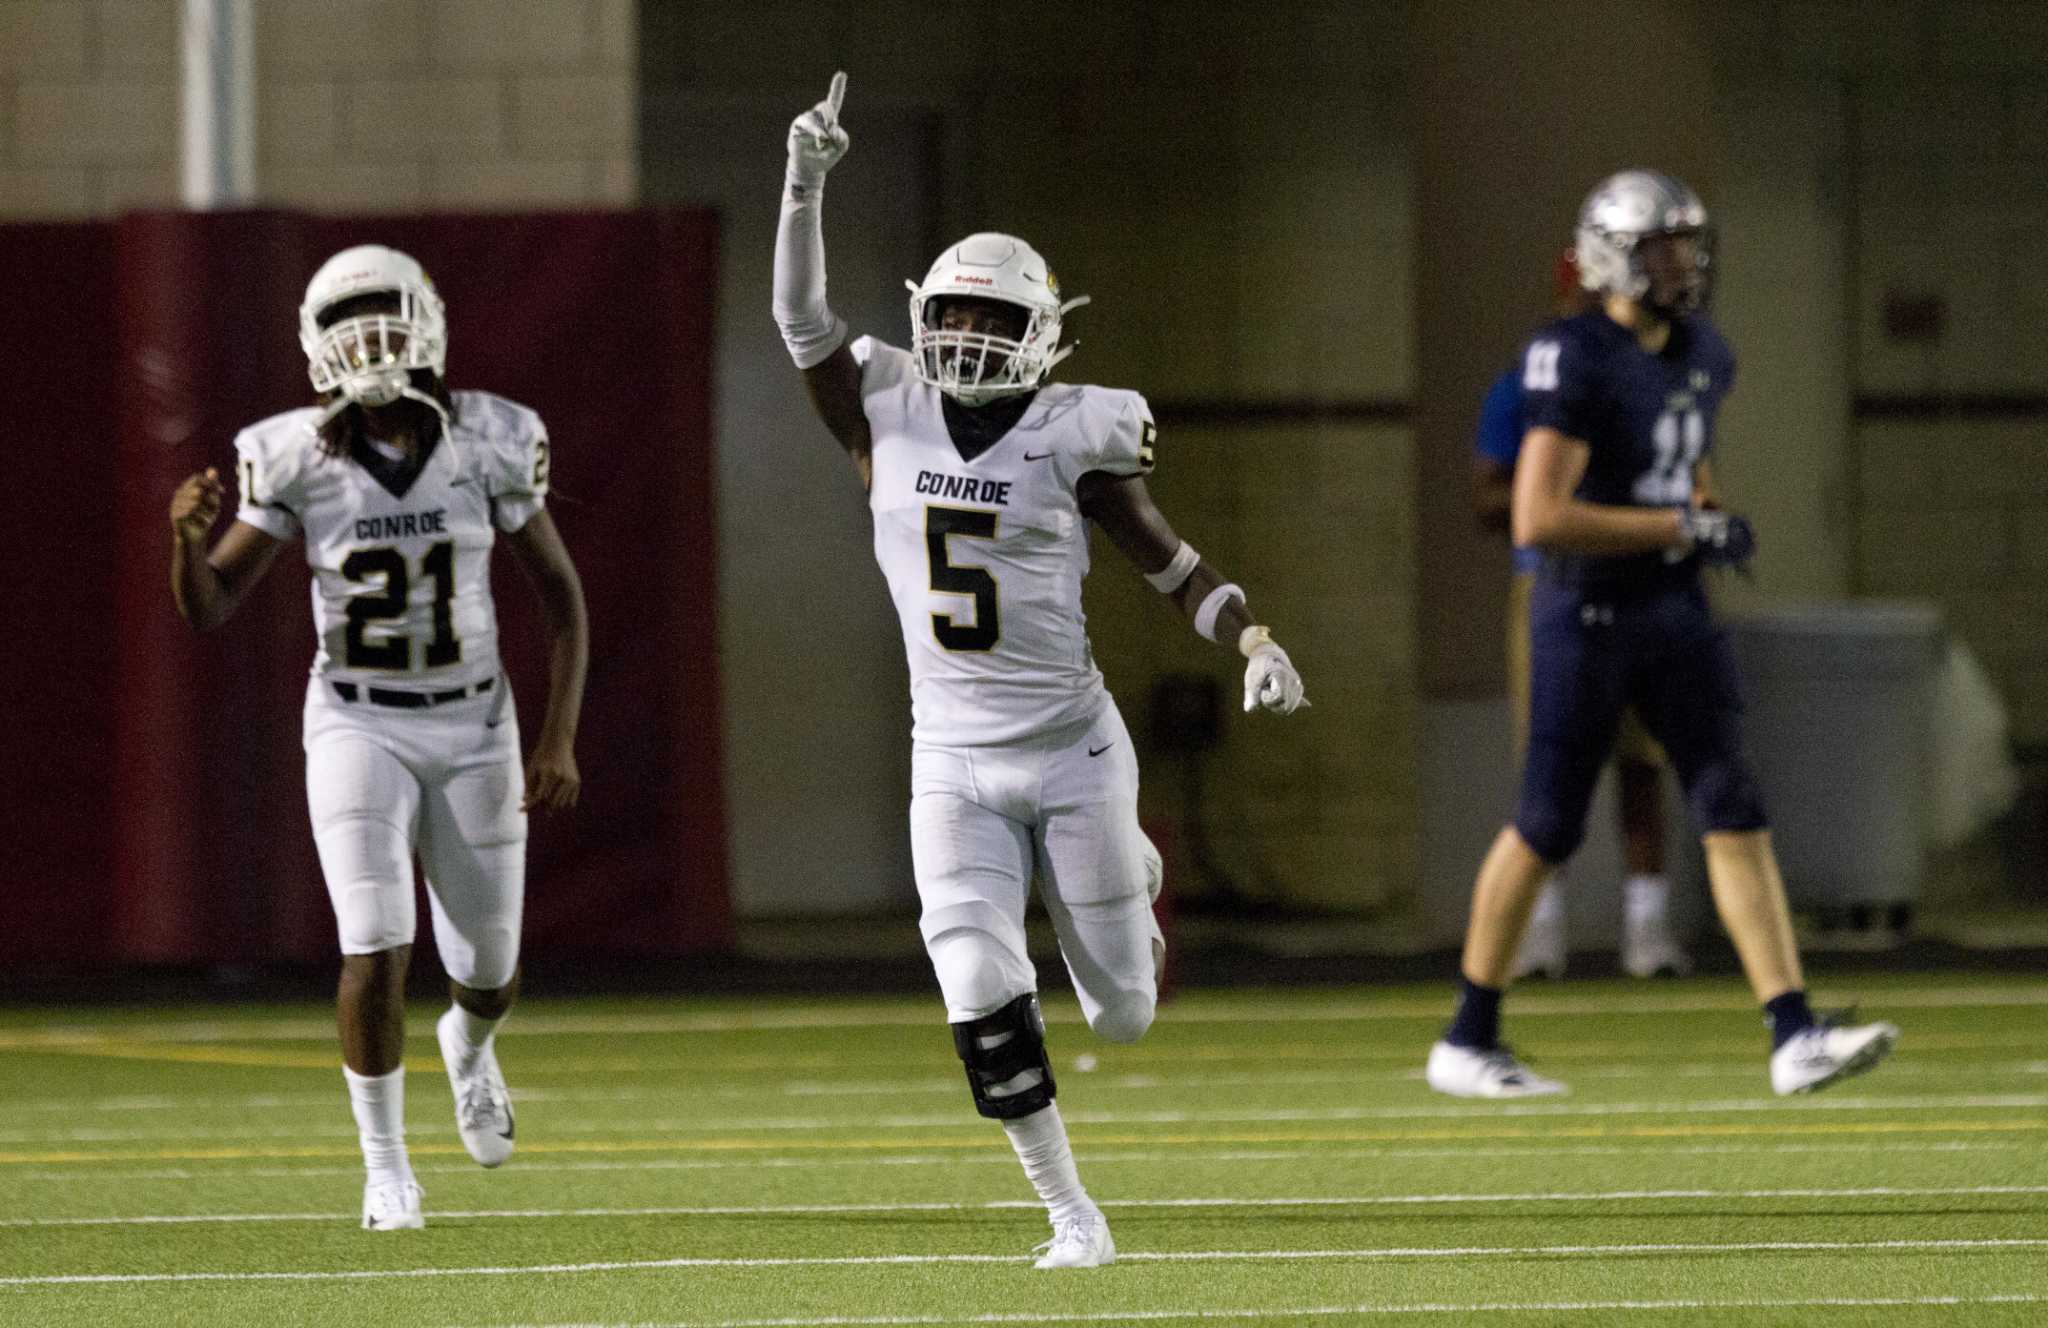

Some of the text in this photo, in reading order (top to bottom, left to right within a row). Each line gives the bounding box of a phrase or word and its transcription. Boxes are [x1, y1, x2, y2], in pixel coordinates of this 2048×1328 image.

[955, 274, 993, 287] Riddell
[915, 470, 1012, 506] CONROE
[356, 508, 449, 541] CONROE
[925, 502, 1001, 654] 5
[340, 539, 464, 672] 21
